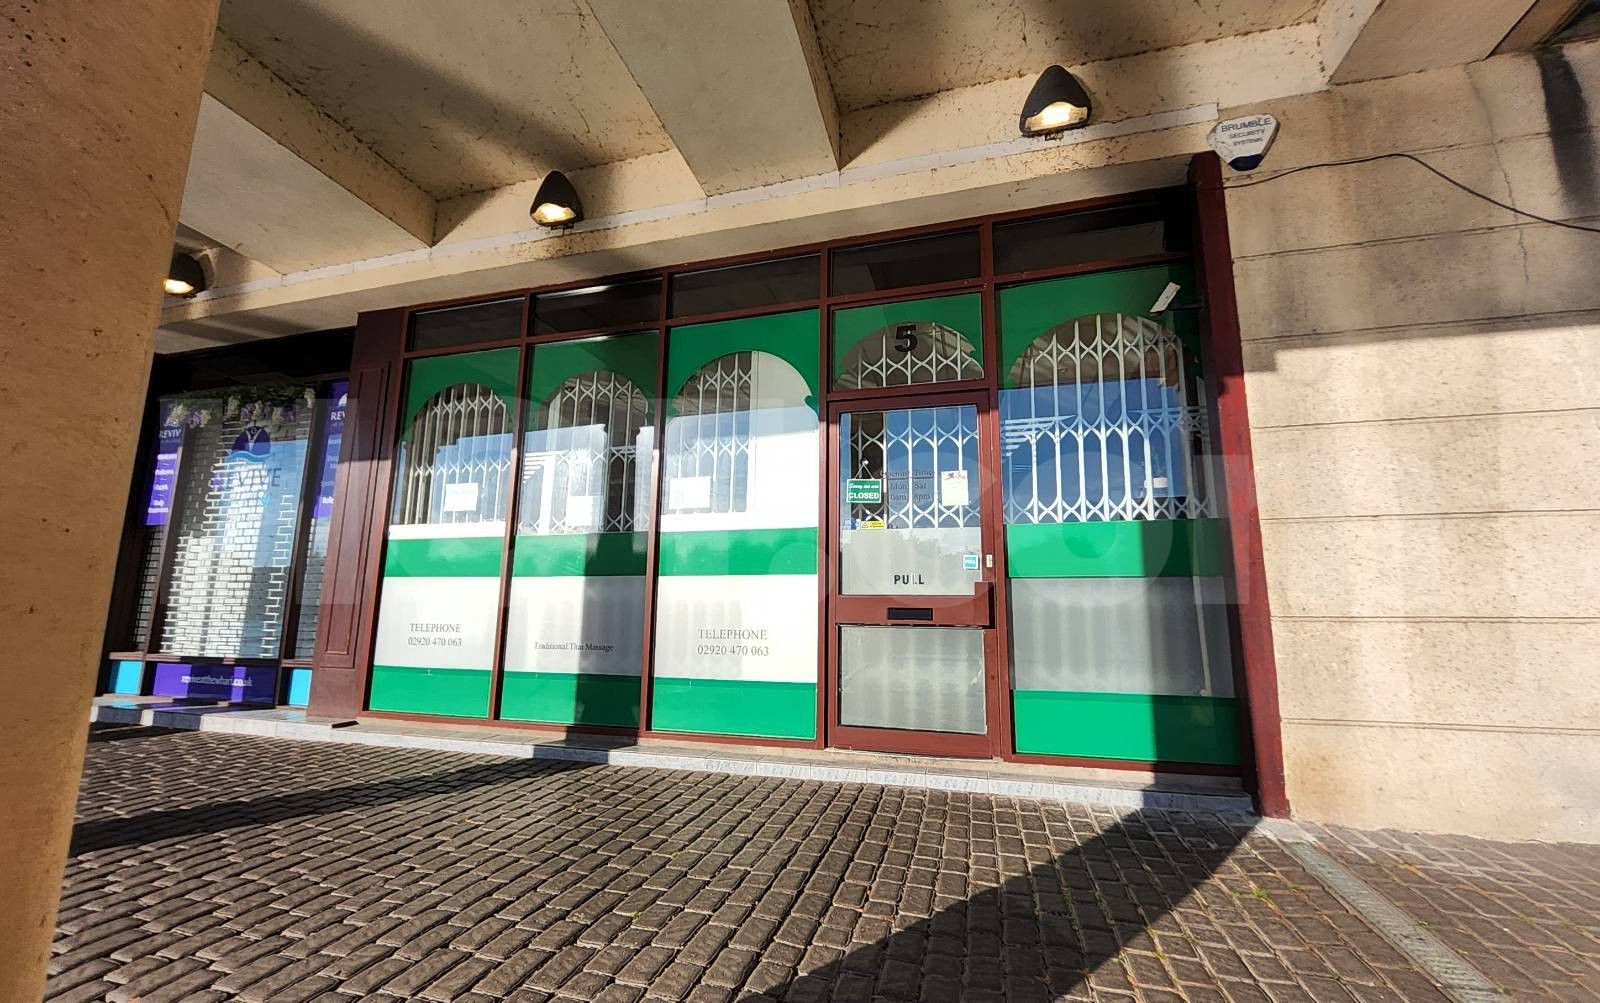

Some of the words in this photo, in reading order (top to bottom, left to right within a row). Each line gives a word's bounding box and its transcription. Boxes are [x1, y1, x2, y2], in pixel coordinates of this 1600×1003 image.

[1221, 117, 1271, 132] BRUMBLE
[895, 325, 918, 352] 5
[848, 491, 880, 500] CLOSED
[409, 623, 462, 633] TELEPHONE
[698, 629, 768, 640] TELEPHONE
[407, 636, 431, 646] 02920
[432, 637, 446, 647] 470
[534, 641, 568, 650] Traditional
[569, 642, 584, 651] Thai
[585, 643, 614, 653] Massage
[697, 645, 727, 655] 02920
[729, 645, 749, 656] 470
[750, 646, 769, 656] 063
